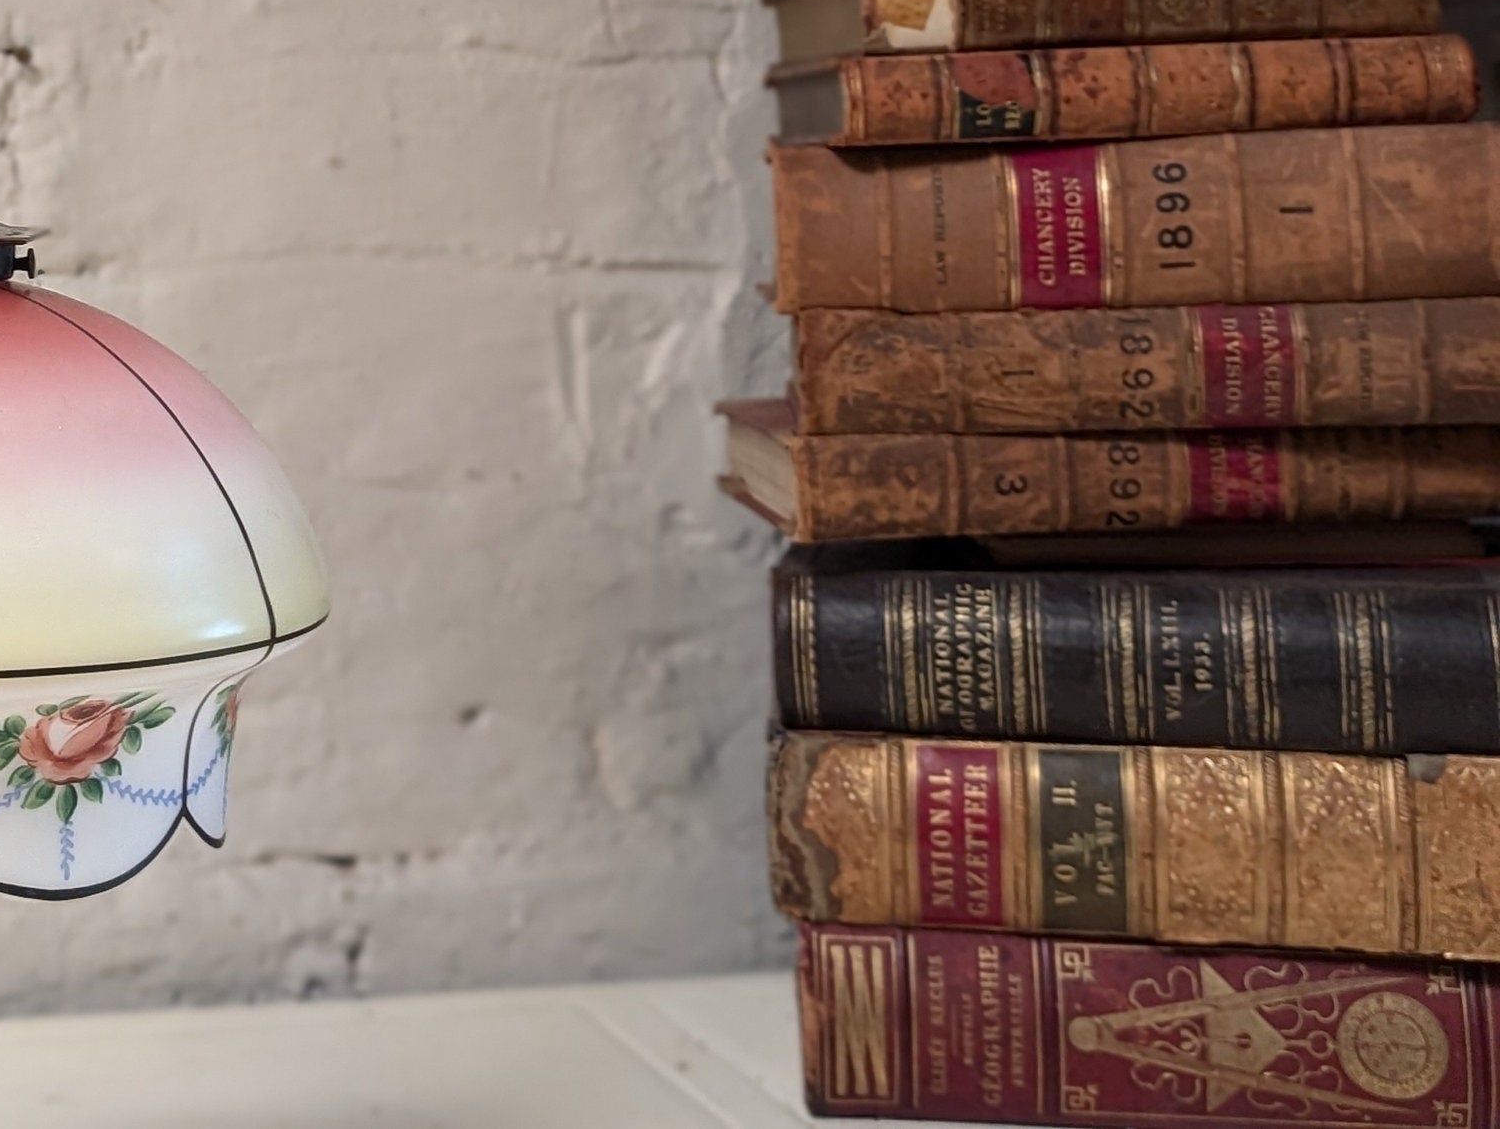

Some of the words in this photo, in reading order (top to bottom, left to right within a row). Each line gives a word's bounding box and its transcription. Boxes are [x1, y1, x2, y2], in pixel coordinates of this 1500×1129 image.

[1031, 167, 1056, 287] CHANCERY
[1061, 176, 1087, 276] DIVISION
[1152, 162, 1195, 272] 1896
[1119, 318, 1155, 420] 1892
[1220, 317, 1243, 416] DIVISION
[1258, 306, 1283, 419] CHANCERY
[995, 474, 1029, 496] 3
[1106, 444, 1142, 526] 892
[933, 593, 955, 715] NATIONAL
[955, 582, 976, 731] GEOGRAPHIC
[974, 588, 995, 713] MAGAZINE
[928, 769, 955, 907] NATIONAL
[964, 764, 989, 917] GAZETTEER
[978, 945, 1002, 1107] GÉOGRAPHIE
